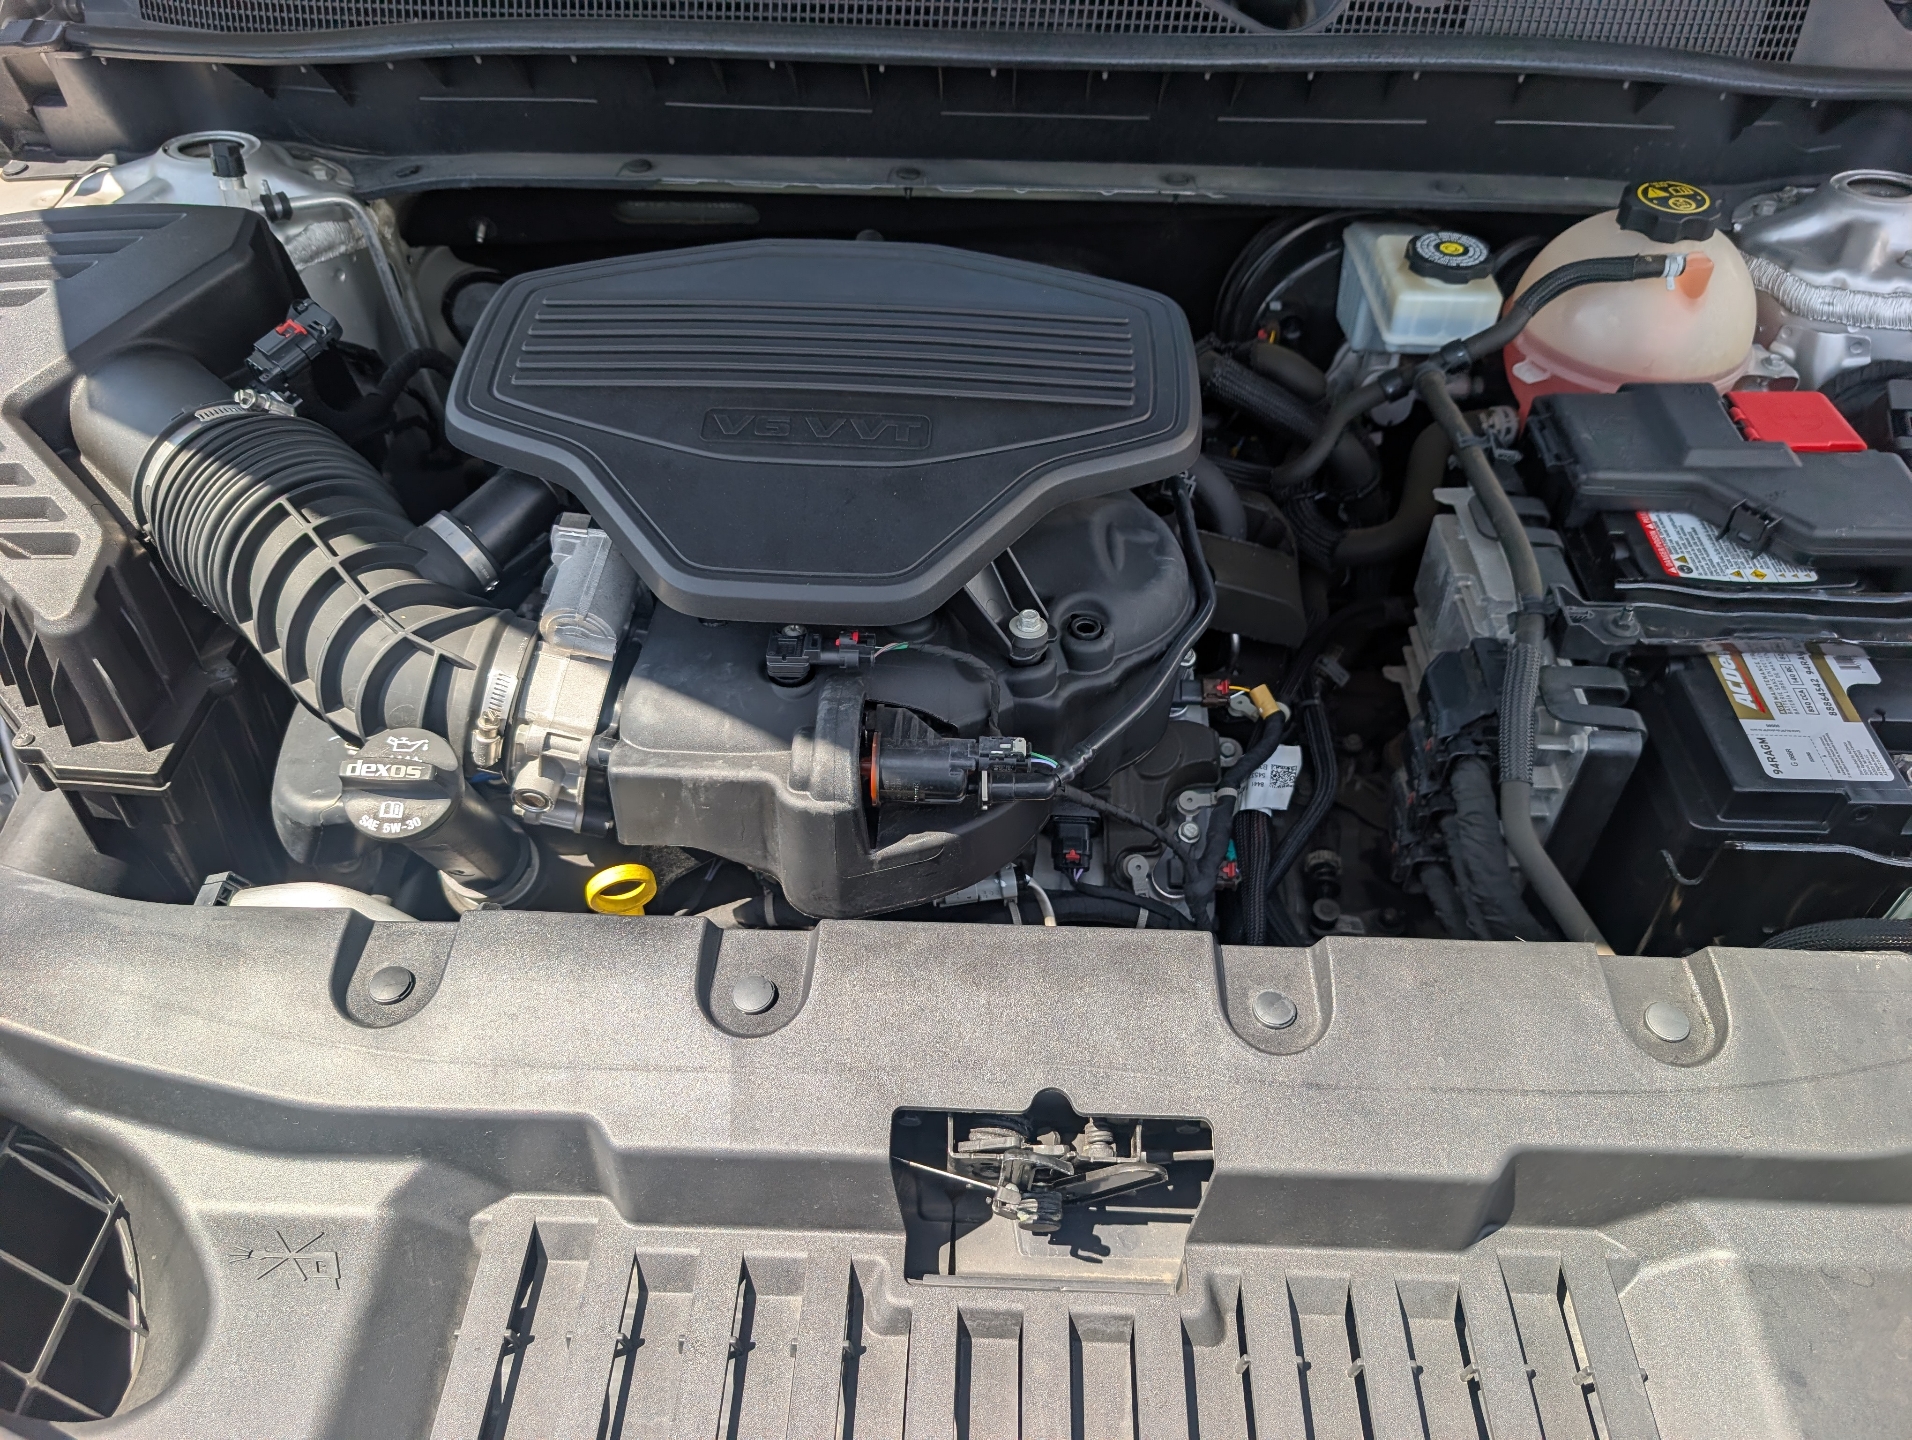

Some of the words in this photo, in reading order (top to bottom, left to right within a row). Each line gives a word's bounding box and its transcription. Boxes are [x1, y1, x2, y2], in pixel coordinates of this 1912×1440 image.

[714, 414, 791, 437] V6
[805, 417, 922, 442] VVT
[1784, 665, 1795, 673] RC
[1754, 661, 1779, 700] MAINTENANCE
[1789, 674, 1800, 684] 140
[1798, 689, 1809, 701] CCA
[1810, 678, 1838, 716] 88864542
[1804, 701, 1815, 713] 850
[1756, 737, 1783, 775] 94RAGM
[345, 760, 422, 779] dexos
[359, 814, 380, 832] SAE
[382, 816, 422, 834] 5W-30
